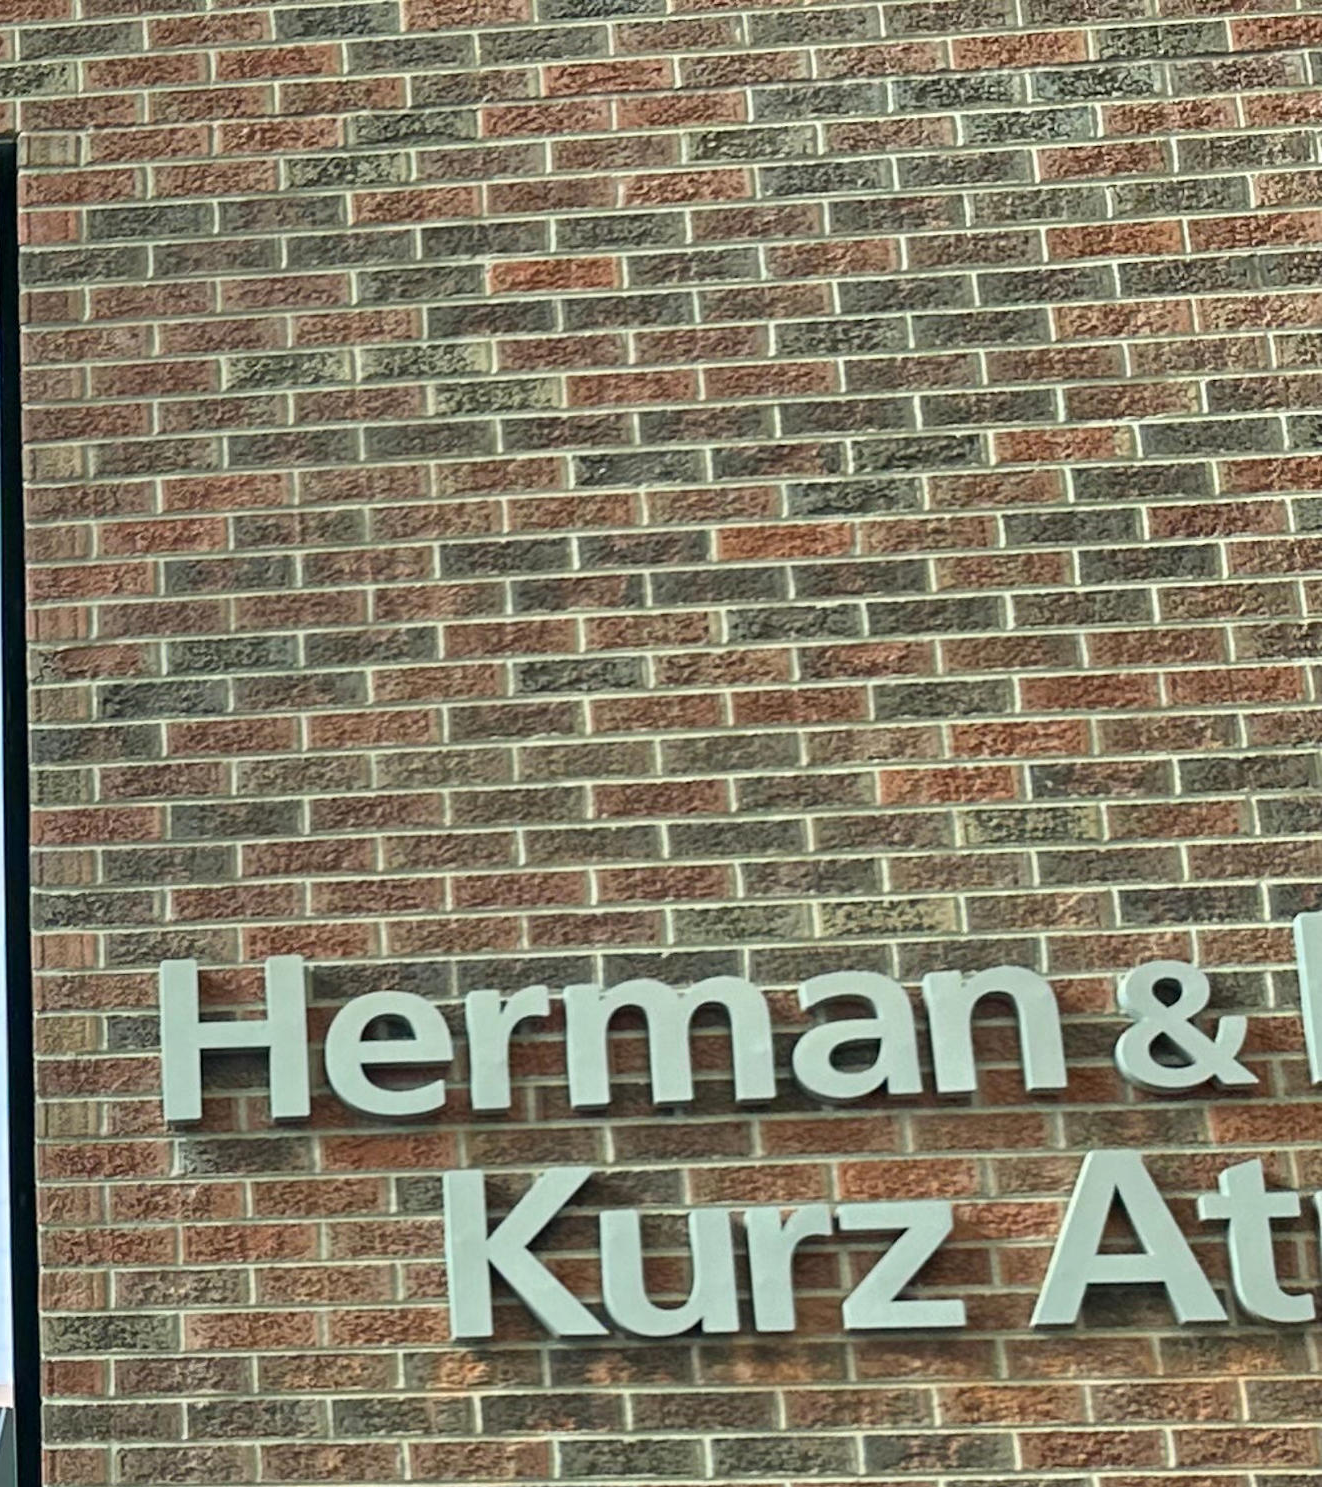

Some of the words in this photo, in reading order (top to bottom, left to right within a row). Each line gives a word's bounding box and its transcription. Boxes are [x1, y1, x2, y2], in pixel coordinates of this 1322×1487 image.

[159, 954, 1068, 1120] Herman
[1114, 960, 1260, 1090] &
[443, 1165, 967, 1339] Kurz
[1029, 1148, 1322, 1327] At
